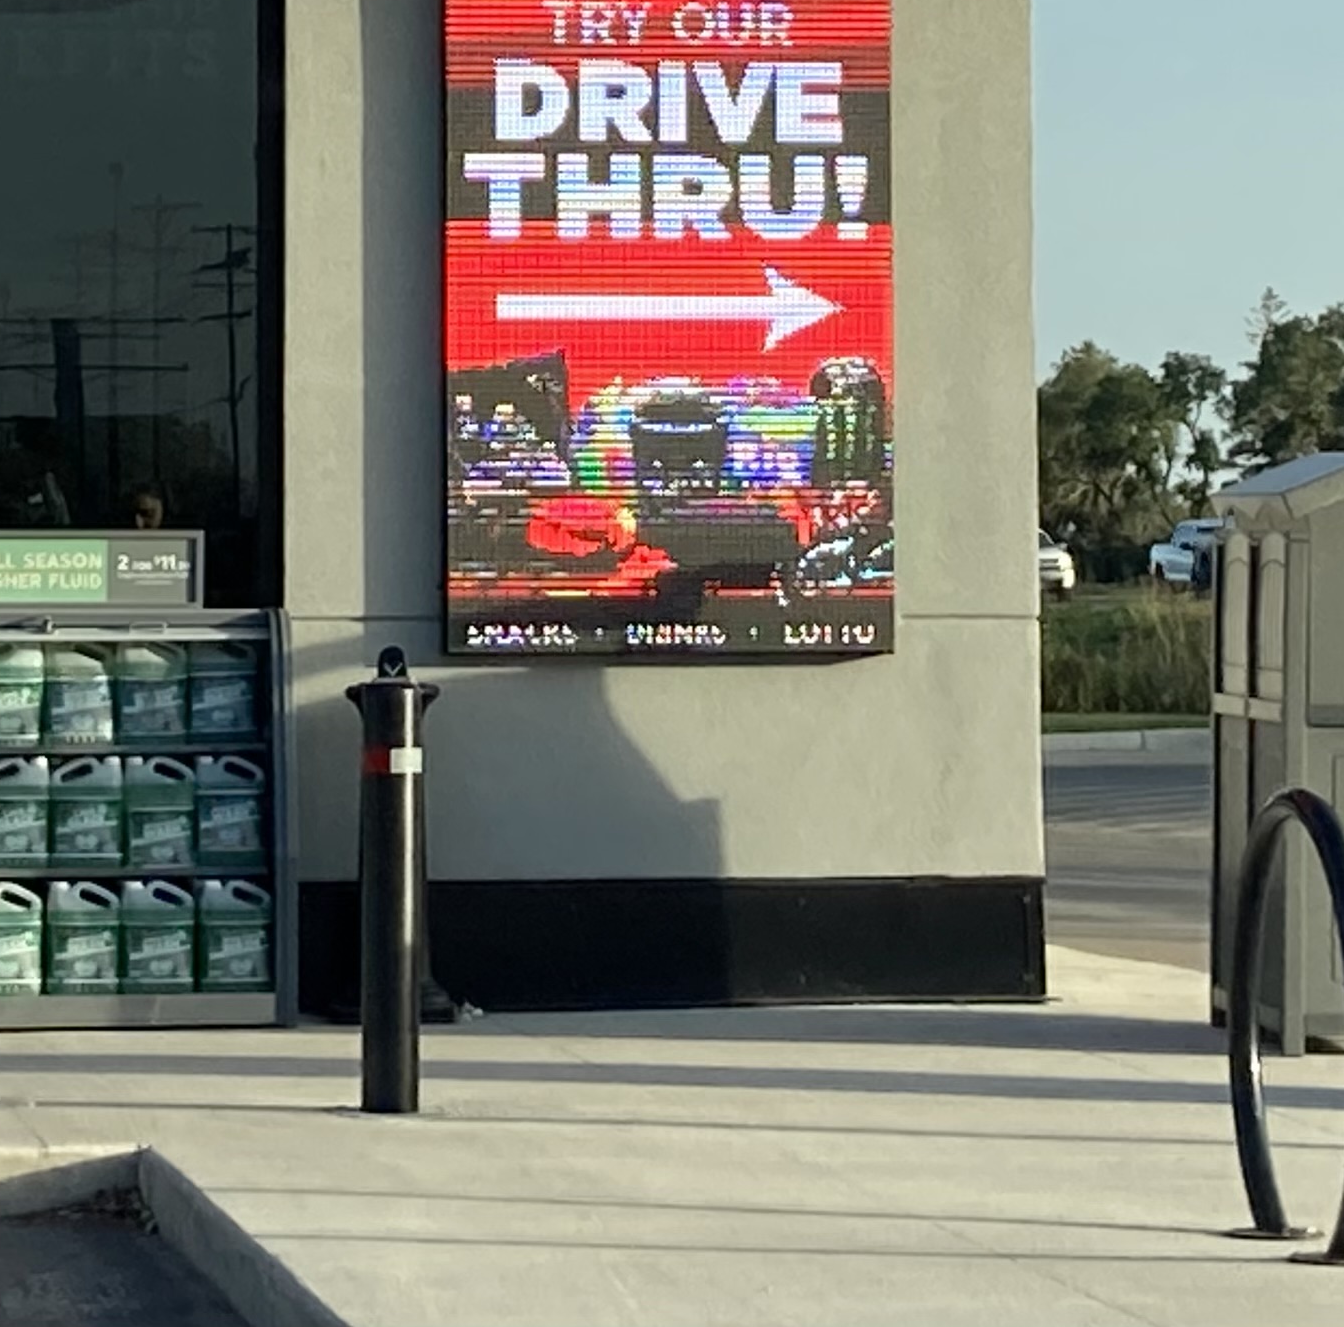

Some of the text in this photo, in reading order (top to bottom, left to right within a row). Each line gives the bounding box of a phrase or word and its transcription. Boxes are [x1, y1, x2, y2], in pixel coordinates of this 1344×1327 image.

[541, 0, 795, 46] TRY OUR
[492, 57, 844, 144] DRIVE
[463, 152, 869, 241] THRU!
[23, 552, 103, 570] SEASON
[116, 554, 130, 571] 2
[48, 573, 103, 590] FLUID
